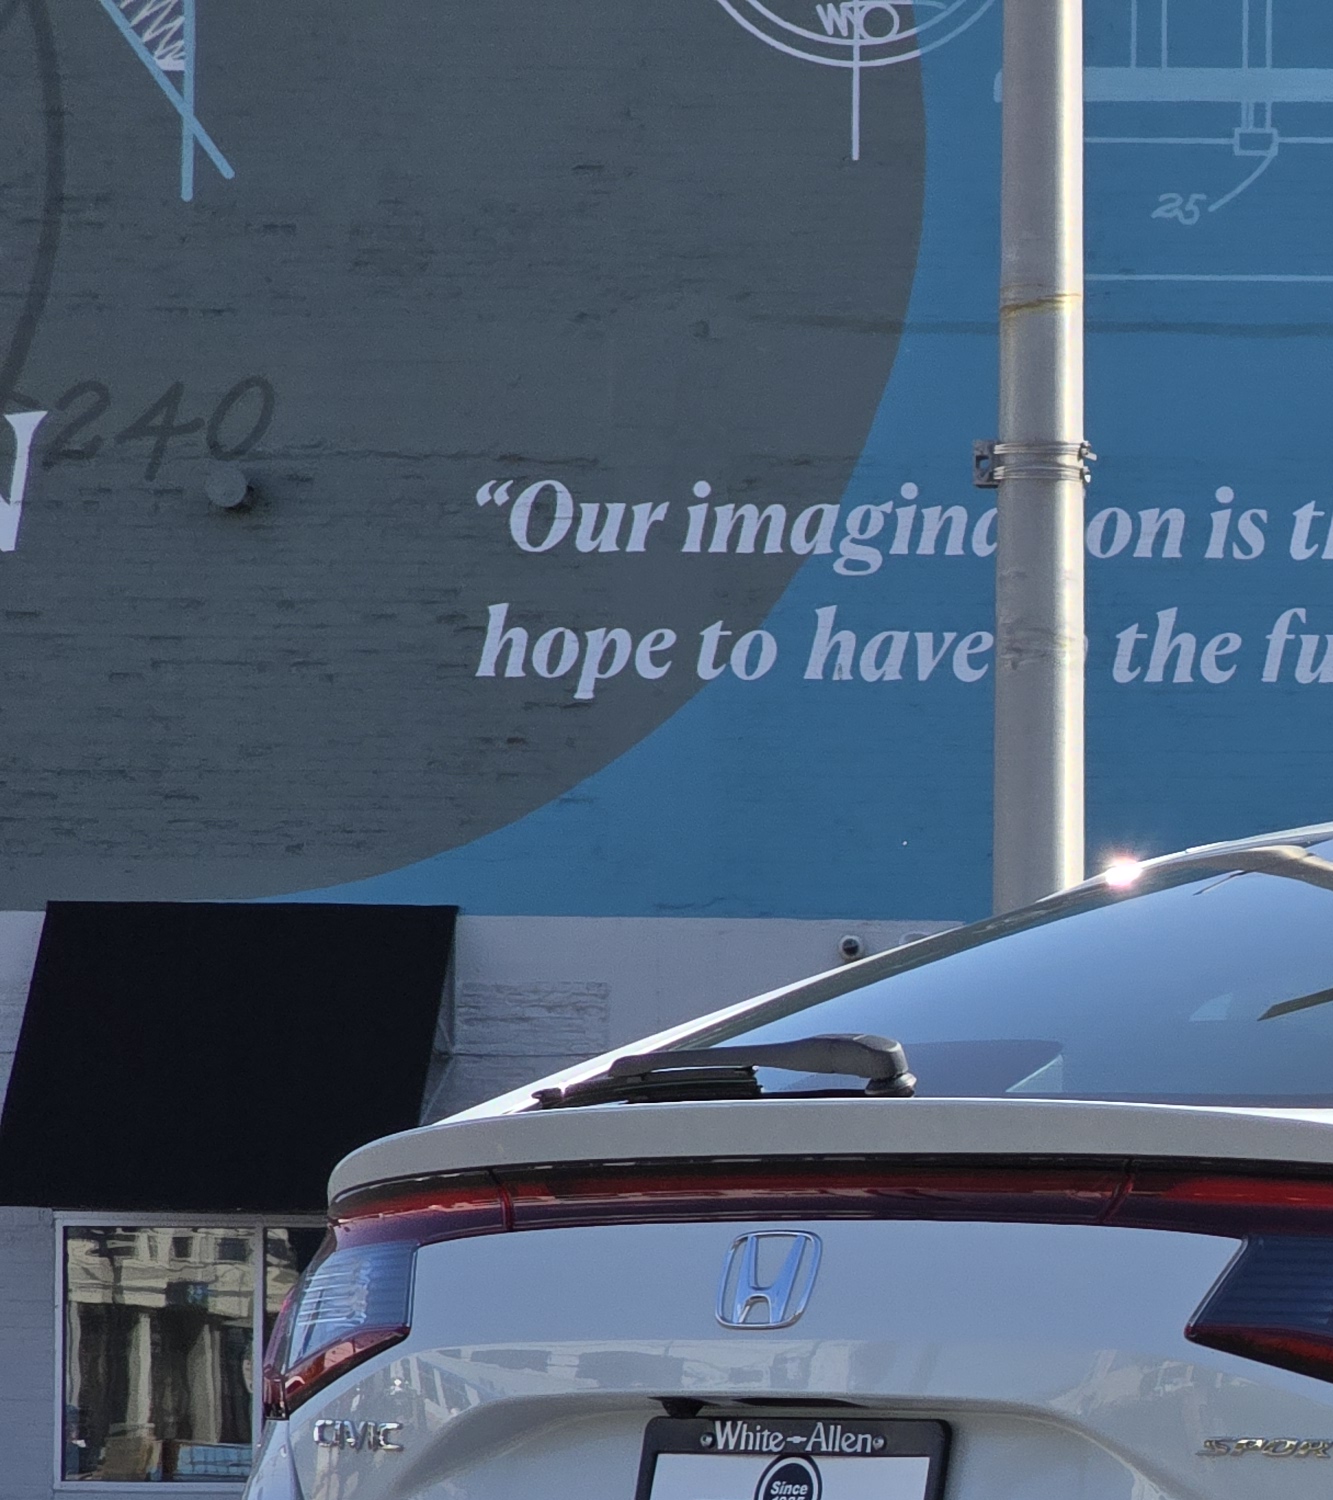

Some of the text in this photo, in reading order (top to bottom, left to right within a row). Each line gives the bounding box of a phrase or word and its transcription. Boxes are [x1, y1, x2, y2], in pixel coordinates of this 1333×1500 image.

[1151, 192, 1210, 226] 25
[42, 375, 276, 483] 240
[679, 479, 1186, 578] imaginon
[1203, 485, 1268, 561] is
[474, 601, 679, 700] hope
[694, 619, 779, 682] to
[802, 604, 995, 684] have
[1111, 606, 1243, 684] the
[313, 1419, 403, 1451] CIVIC
[770, 1480, 808, 1497] Since
